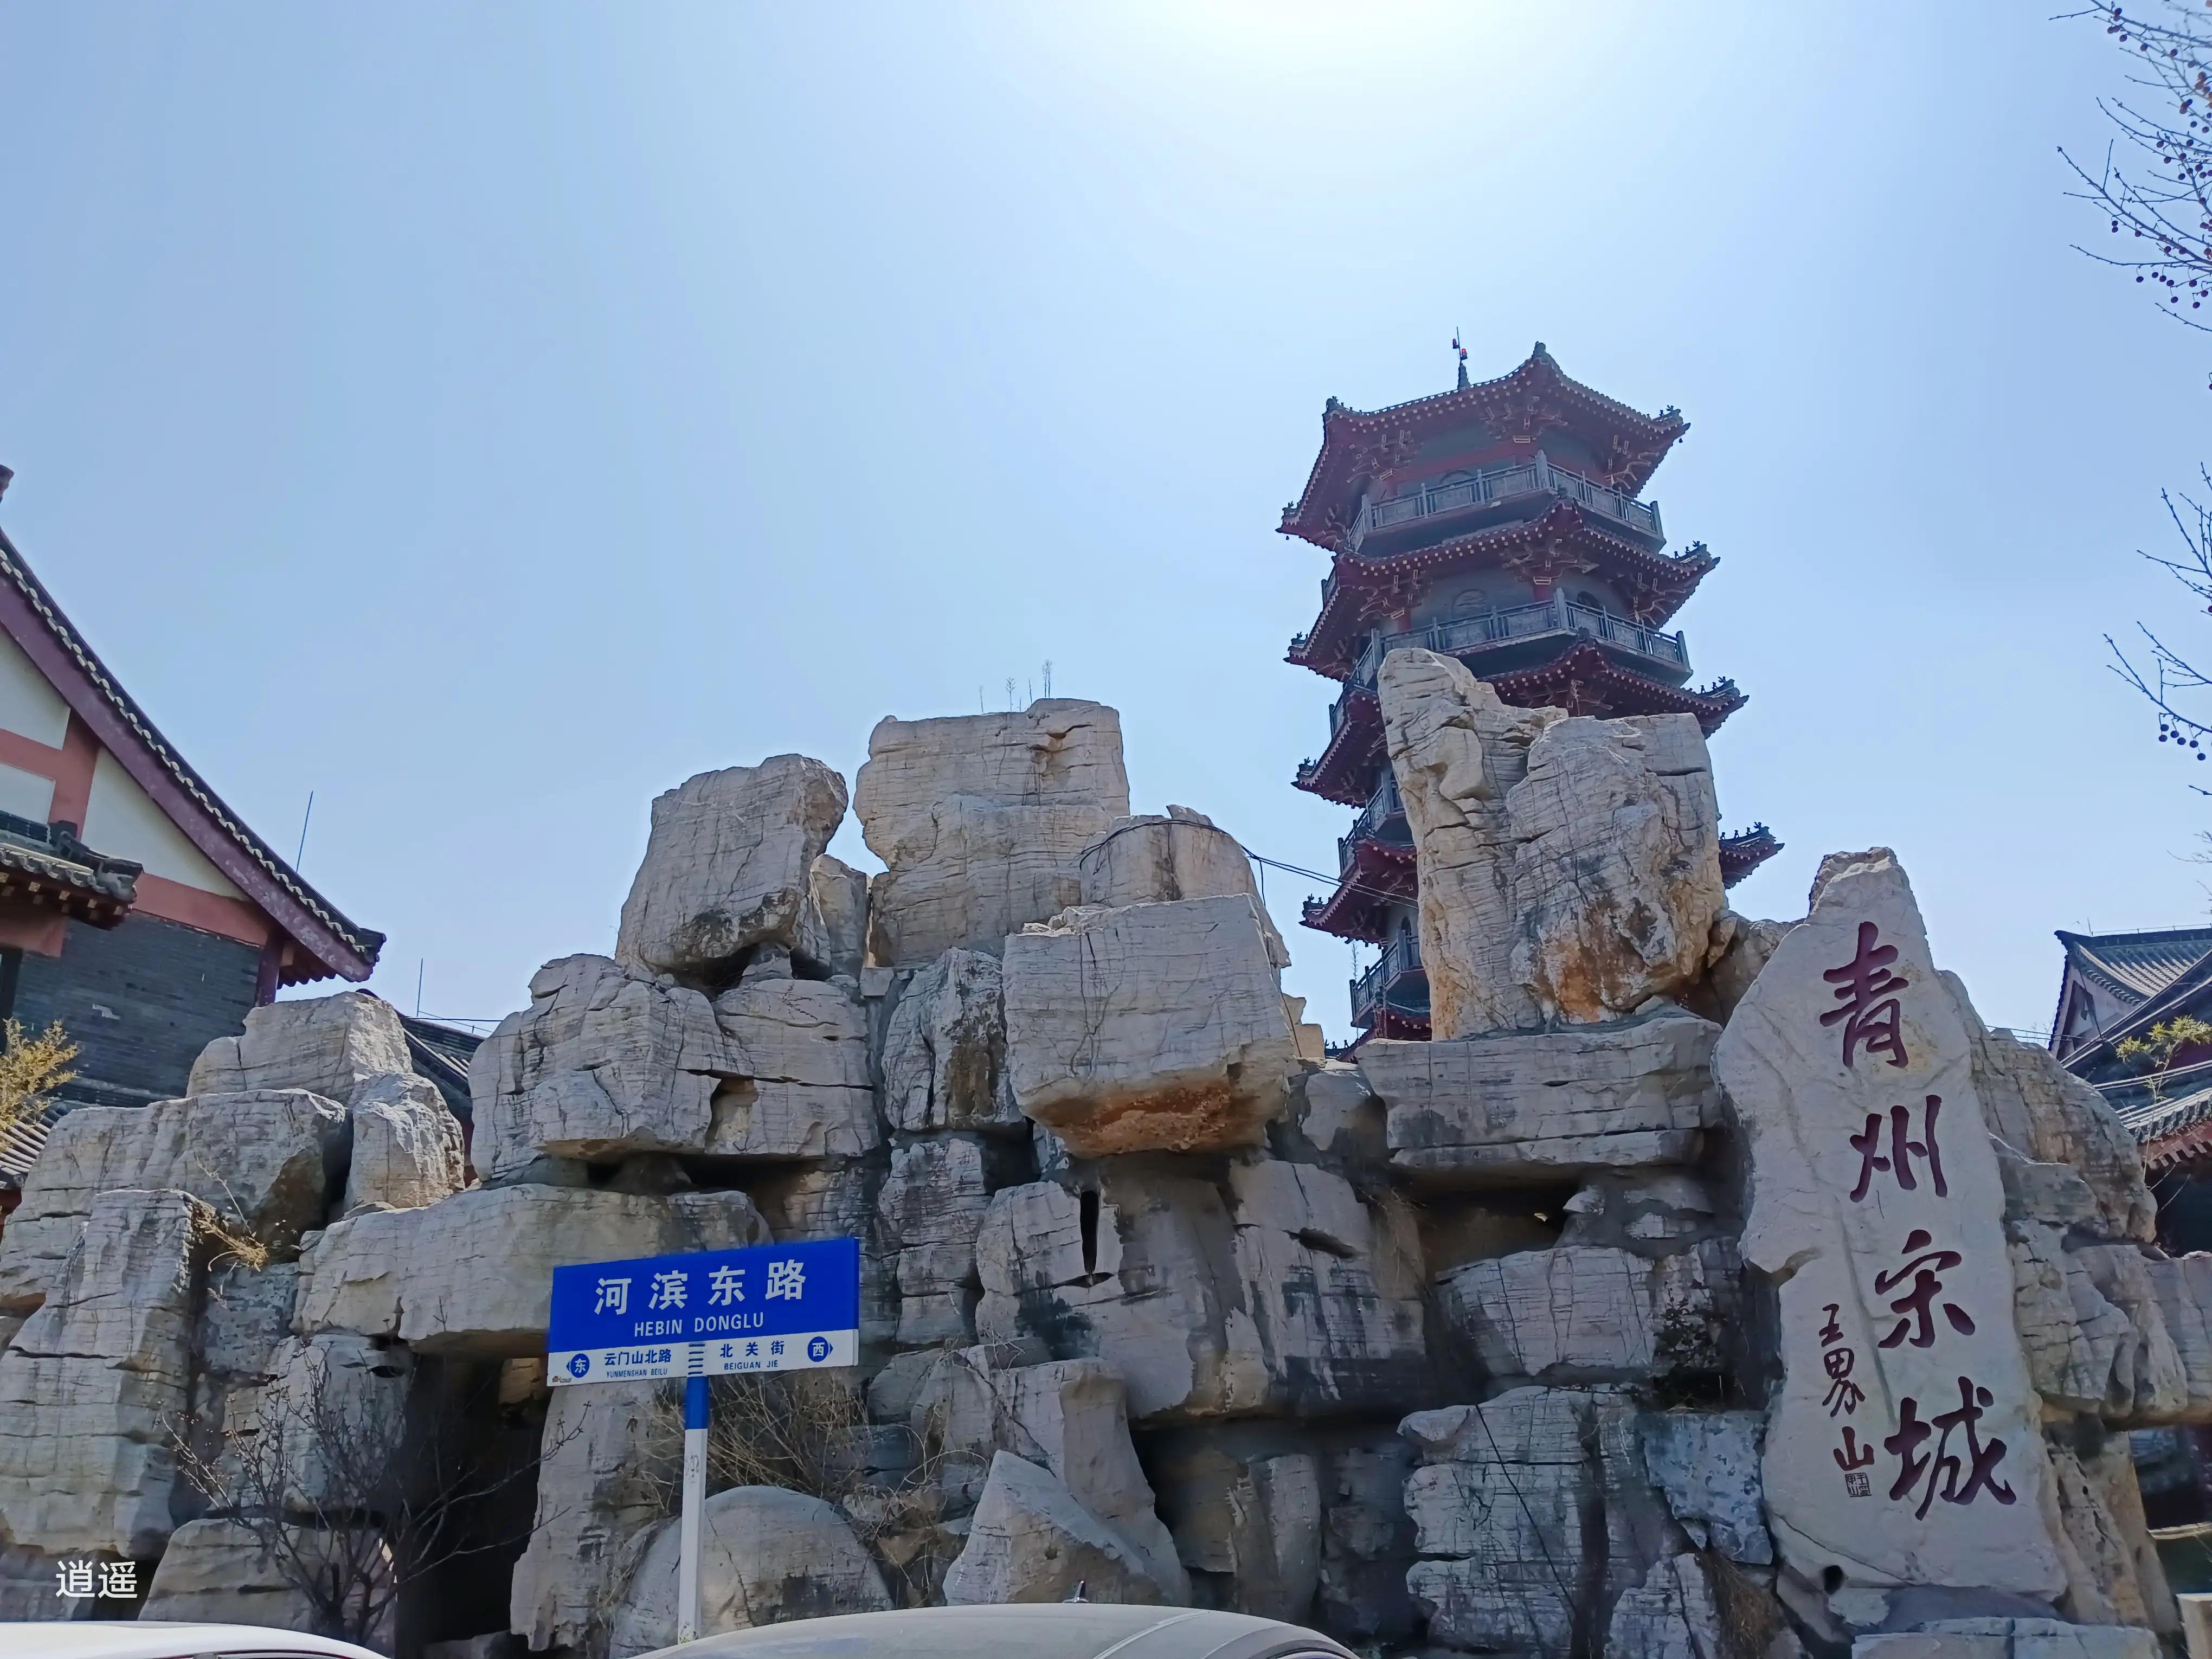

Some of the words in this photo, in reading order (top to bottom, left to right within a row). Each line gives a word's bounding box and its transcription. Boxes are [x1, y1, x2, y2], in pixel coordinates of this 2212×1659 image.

[1819, 921, 2016, 1521] 青州宋城
[594, 1259, 806, 1315] 河滨东路
[634, 1319, 683, 1337] HEBIN
[694, 1311, 764, 1334] DONGLU
[604, 1348, 672, 1366] 云门山北路
[719, 1340, 785, 1358] 北关街
[812, 1342, 825, 1357] 西
[574, 1358, 587, 1373] 东
[606, 1369, 647, 1378] YUNMENSHAN
[724, 1361, 761, 1370] BEIGUAN
[767, 1360, 779, 1368] JIE
